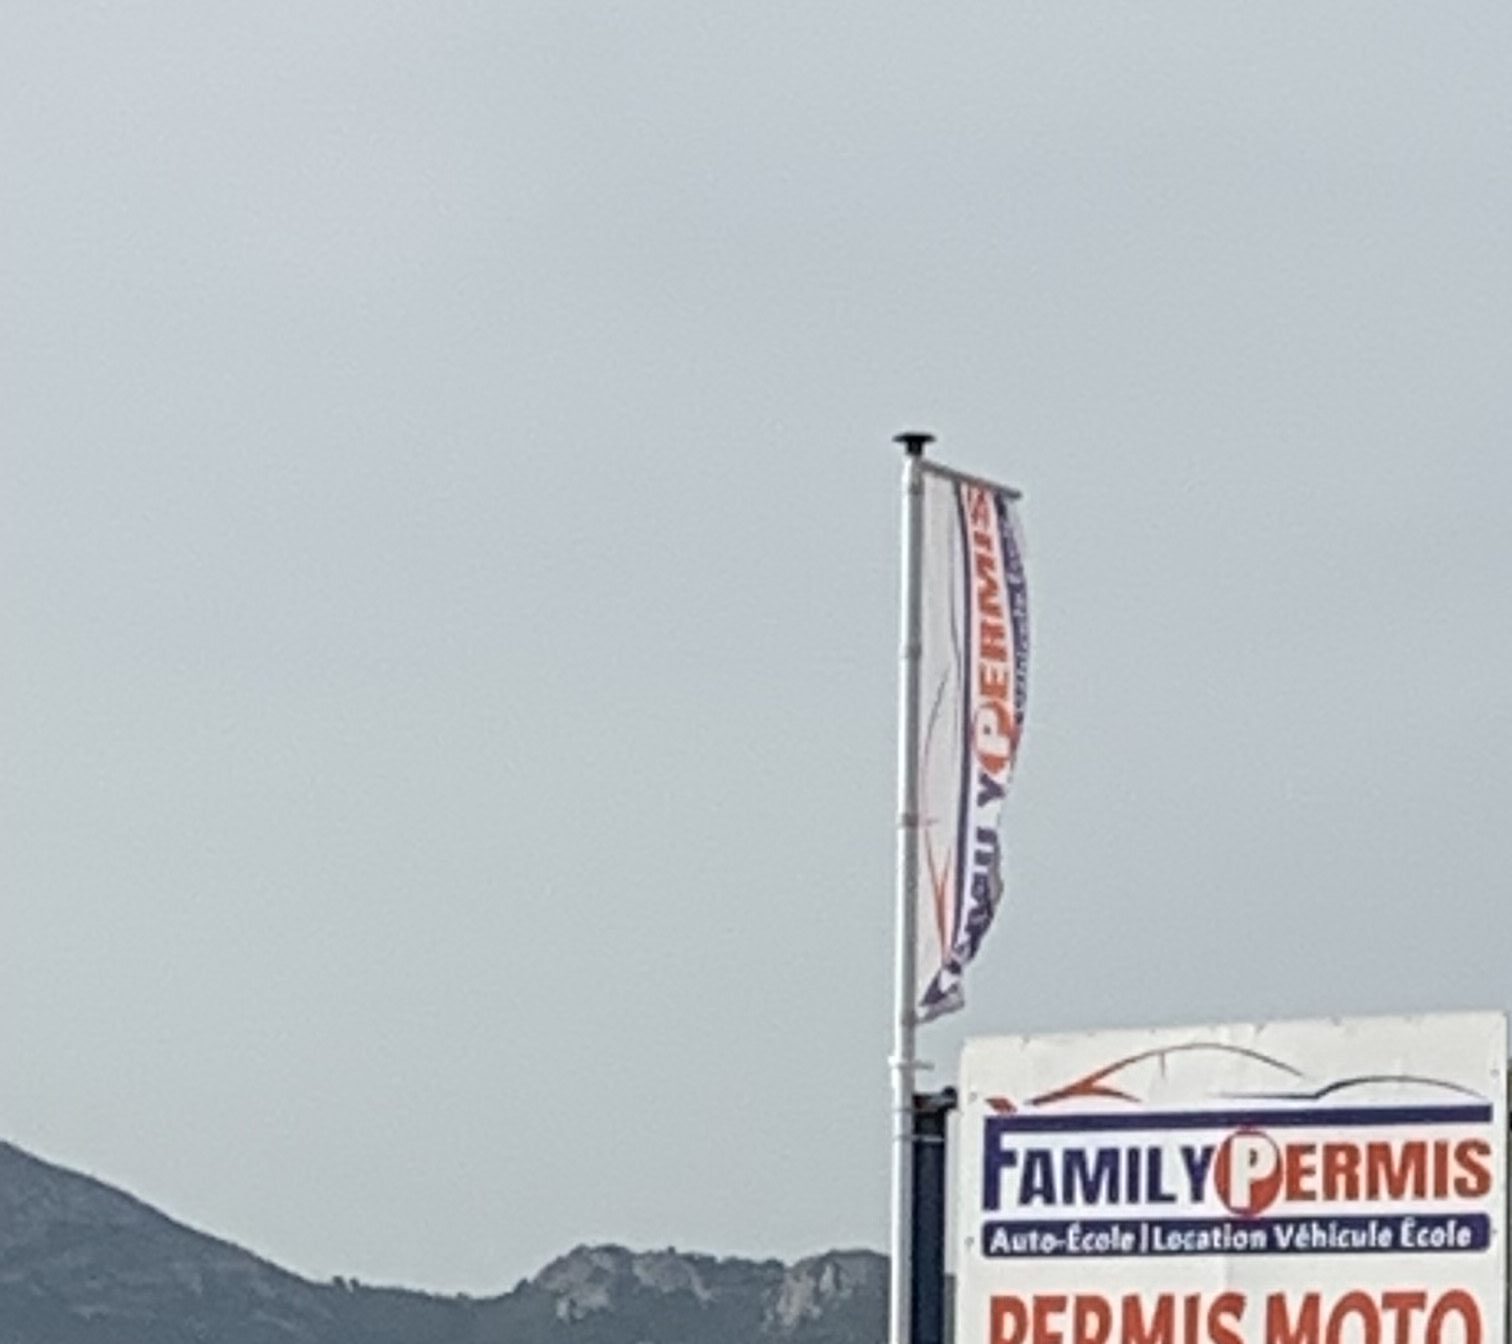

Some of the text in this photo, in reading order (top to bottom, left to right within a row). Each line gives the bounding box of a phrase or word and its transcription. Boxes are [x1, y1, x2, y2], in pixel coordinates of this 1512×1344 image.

[989, 1217, 1473, 1254] Auto-École Location Véhicule École
